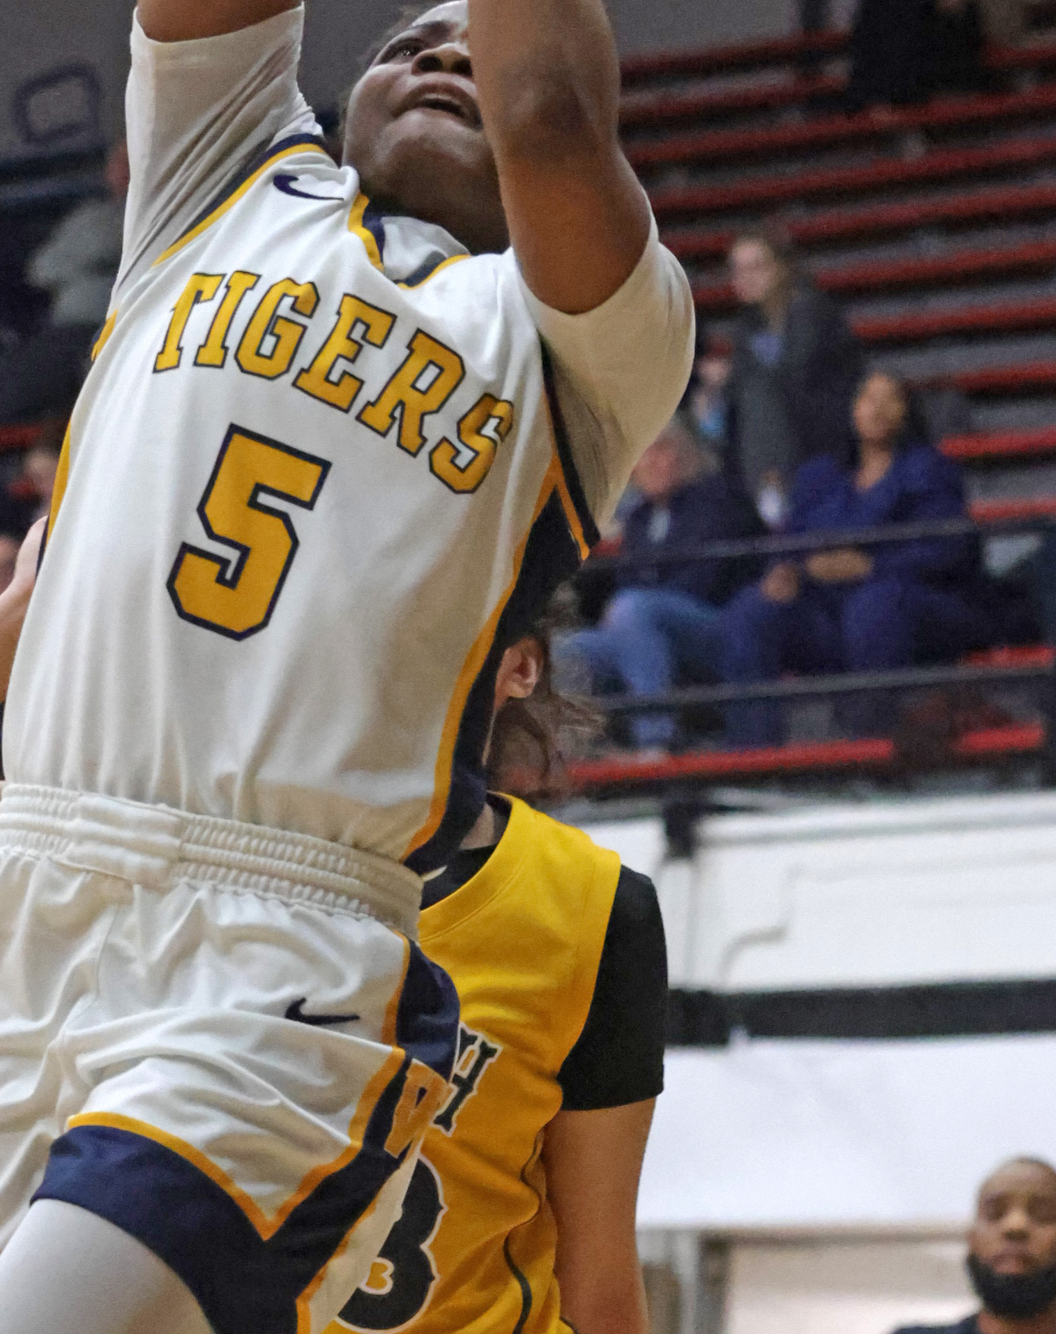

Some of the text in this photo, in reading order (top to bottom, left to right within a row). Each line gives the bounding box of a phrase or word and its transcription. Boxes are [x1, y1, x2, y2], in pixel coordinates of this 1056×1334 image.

[150, 269, 515, 495] TIGERS
[165, 422, 333, 643] 5
[431, 1021, 504, 1137] H
